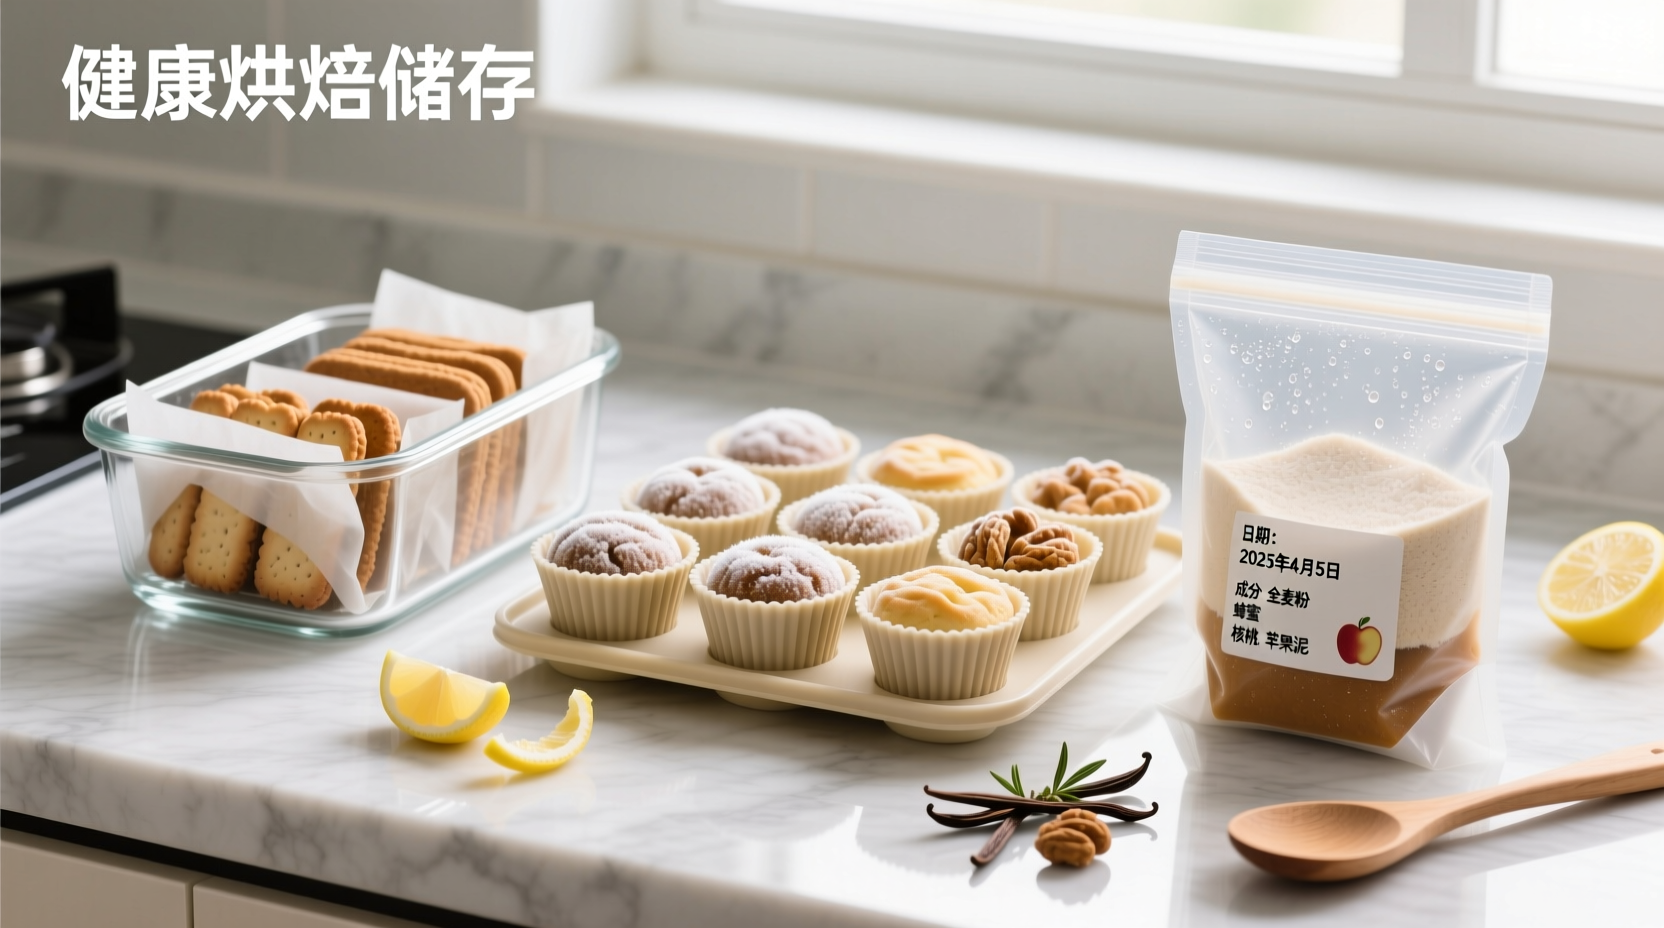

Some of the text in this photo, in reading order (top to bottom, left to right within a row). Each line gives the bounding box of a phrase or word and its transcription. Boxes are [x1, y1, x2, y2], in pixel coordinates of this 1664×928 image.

[1239, 548, 1340, 580] 2025年4月5日
[1235, 580, 1311, 609] 成分 全麦粉
